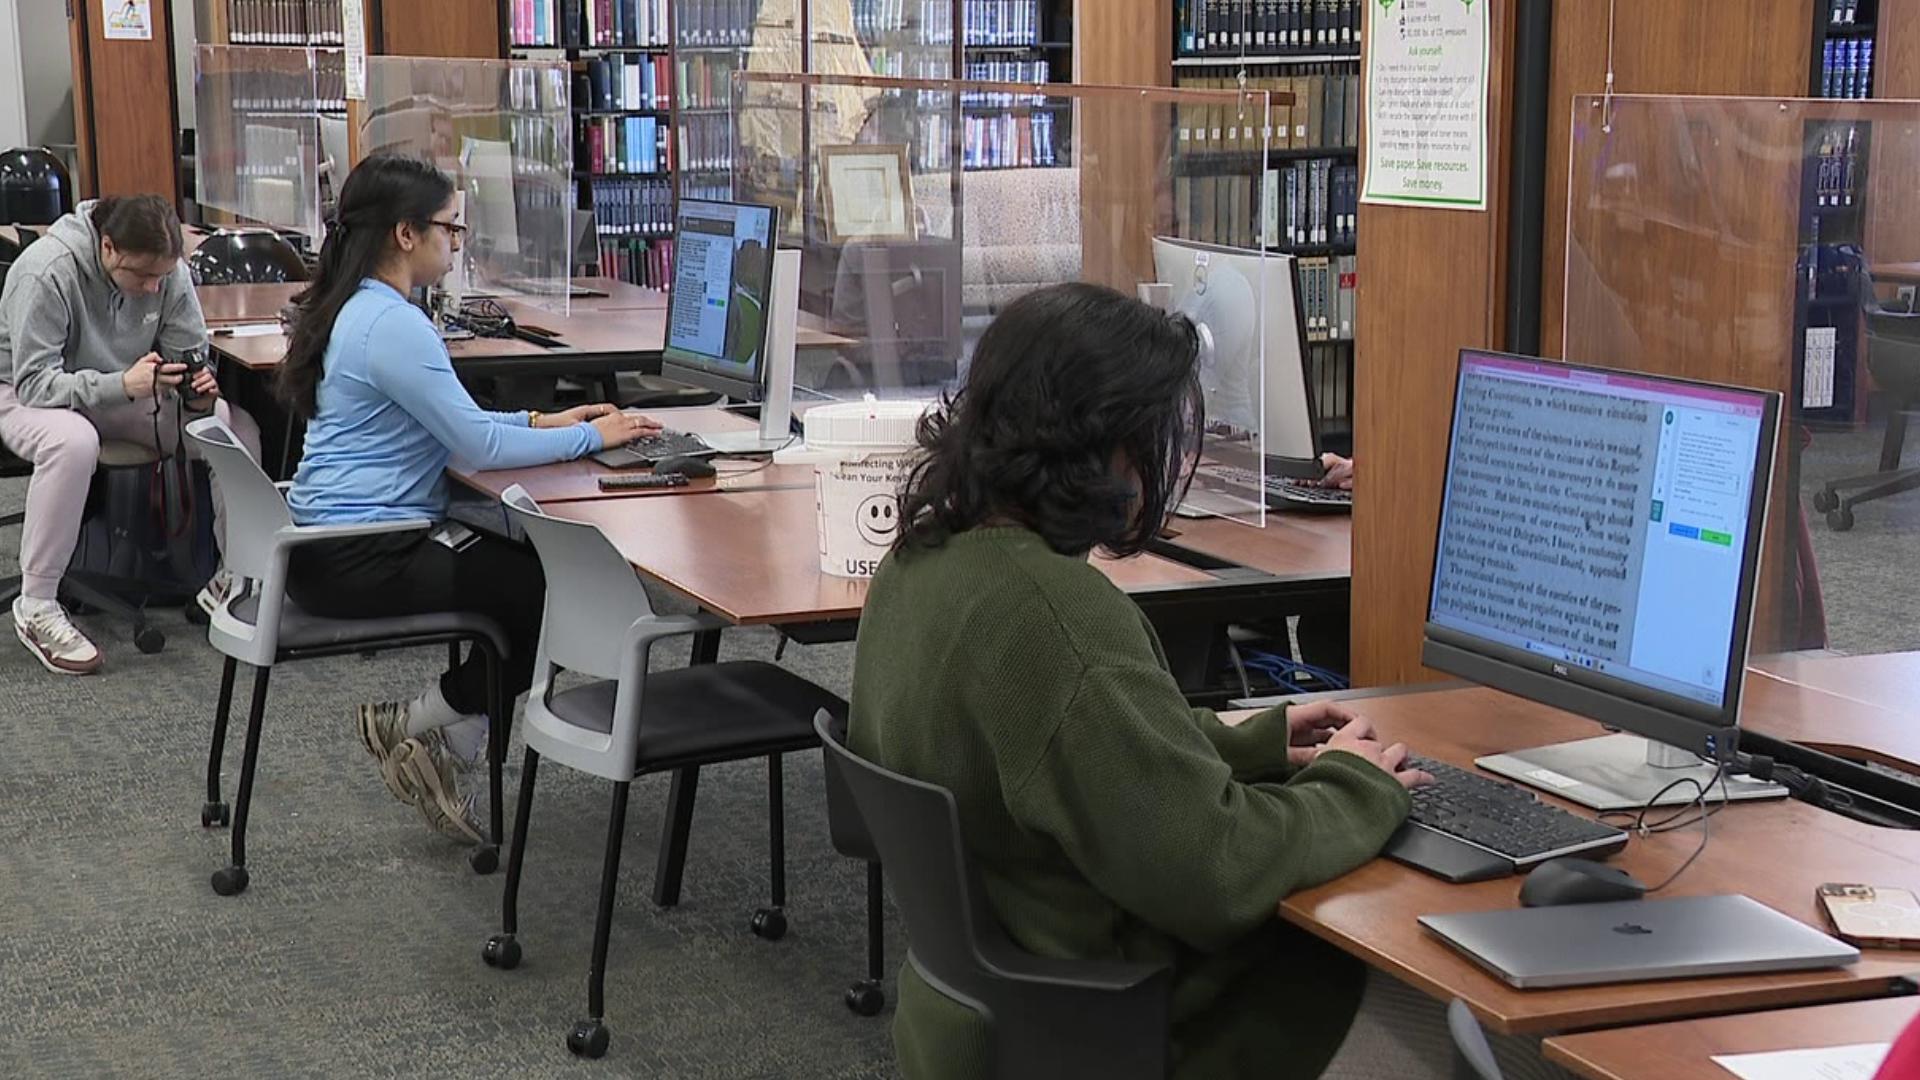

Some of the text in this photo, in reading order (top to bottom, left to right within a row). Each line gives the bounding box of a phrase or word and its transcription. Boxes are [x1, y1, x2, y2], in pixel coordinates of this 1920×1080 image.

[1380, 158, 1469, 172] Save paper. Save resources.
[1402, 177, 1418, 188] Save
[1521, 426, 1531, 438] of
[1530, 427, 1541, 440] the
[1582, 436, 1605, 451] which
[1543, 447, 1554, 460] the
[860, 473, 883, 482] Your
[1563, 486, 1607, 506] Convention
[1529, 514, 1538, 525] of
[1607, 530, 1631, 547] which
[1454, 530, 1465, 543] the
[1487, 538, 1496, 550] of
[1496, 540, 1507, 552] the
[1510, 543, 1559, 565] Conventional
[1559, 554, 1585, 575] Board,
[1589, 564, 1627, 580] appended
[1456, 547, 1485, 568] following
[846, 559, 877, 576] USE
[1449, 560, 1463, 575] The
[1526, 581, 1535, 593] of
[1535, 582, 1548, 597] the
[1578, 594, 1589, 607] of
[1589, 596, 1602, 611] the
[1517, 595, 1528, 610] the
[1564, 610, 1592, 626] against
[1534, 618, 1546, 632] the
[1570, 628, 1581, 640] of
[1582, 630, 1594, 644] the
[1597, 639, 1617, 650] most
